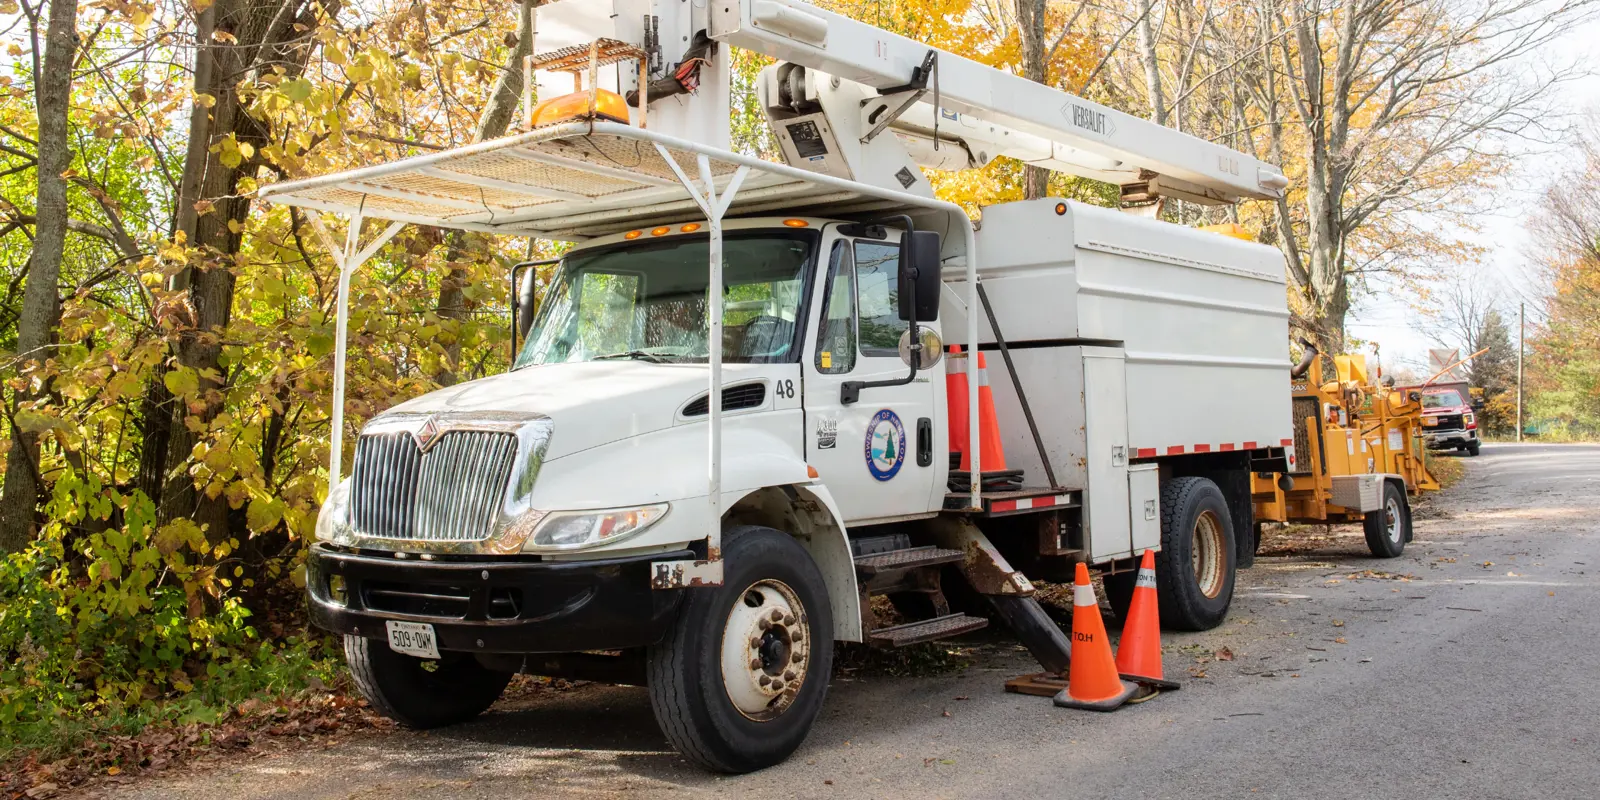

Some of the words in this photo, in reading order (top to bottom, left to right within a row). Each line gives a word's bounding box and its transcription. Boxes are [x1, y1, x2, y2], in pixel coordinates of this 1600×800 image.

[1072, 104, 1106, 135] VERSALIFT
[776, 379, 795, 399] 48
[866, 414, 881, 464] TOWNSHIP
[881, 411, 890, 419] OF
